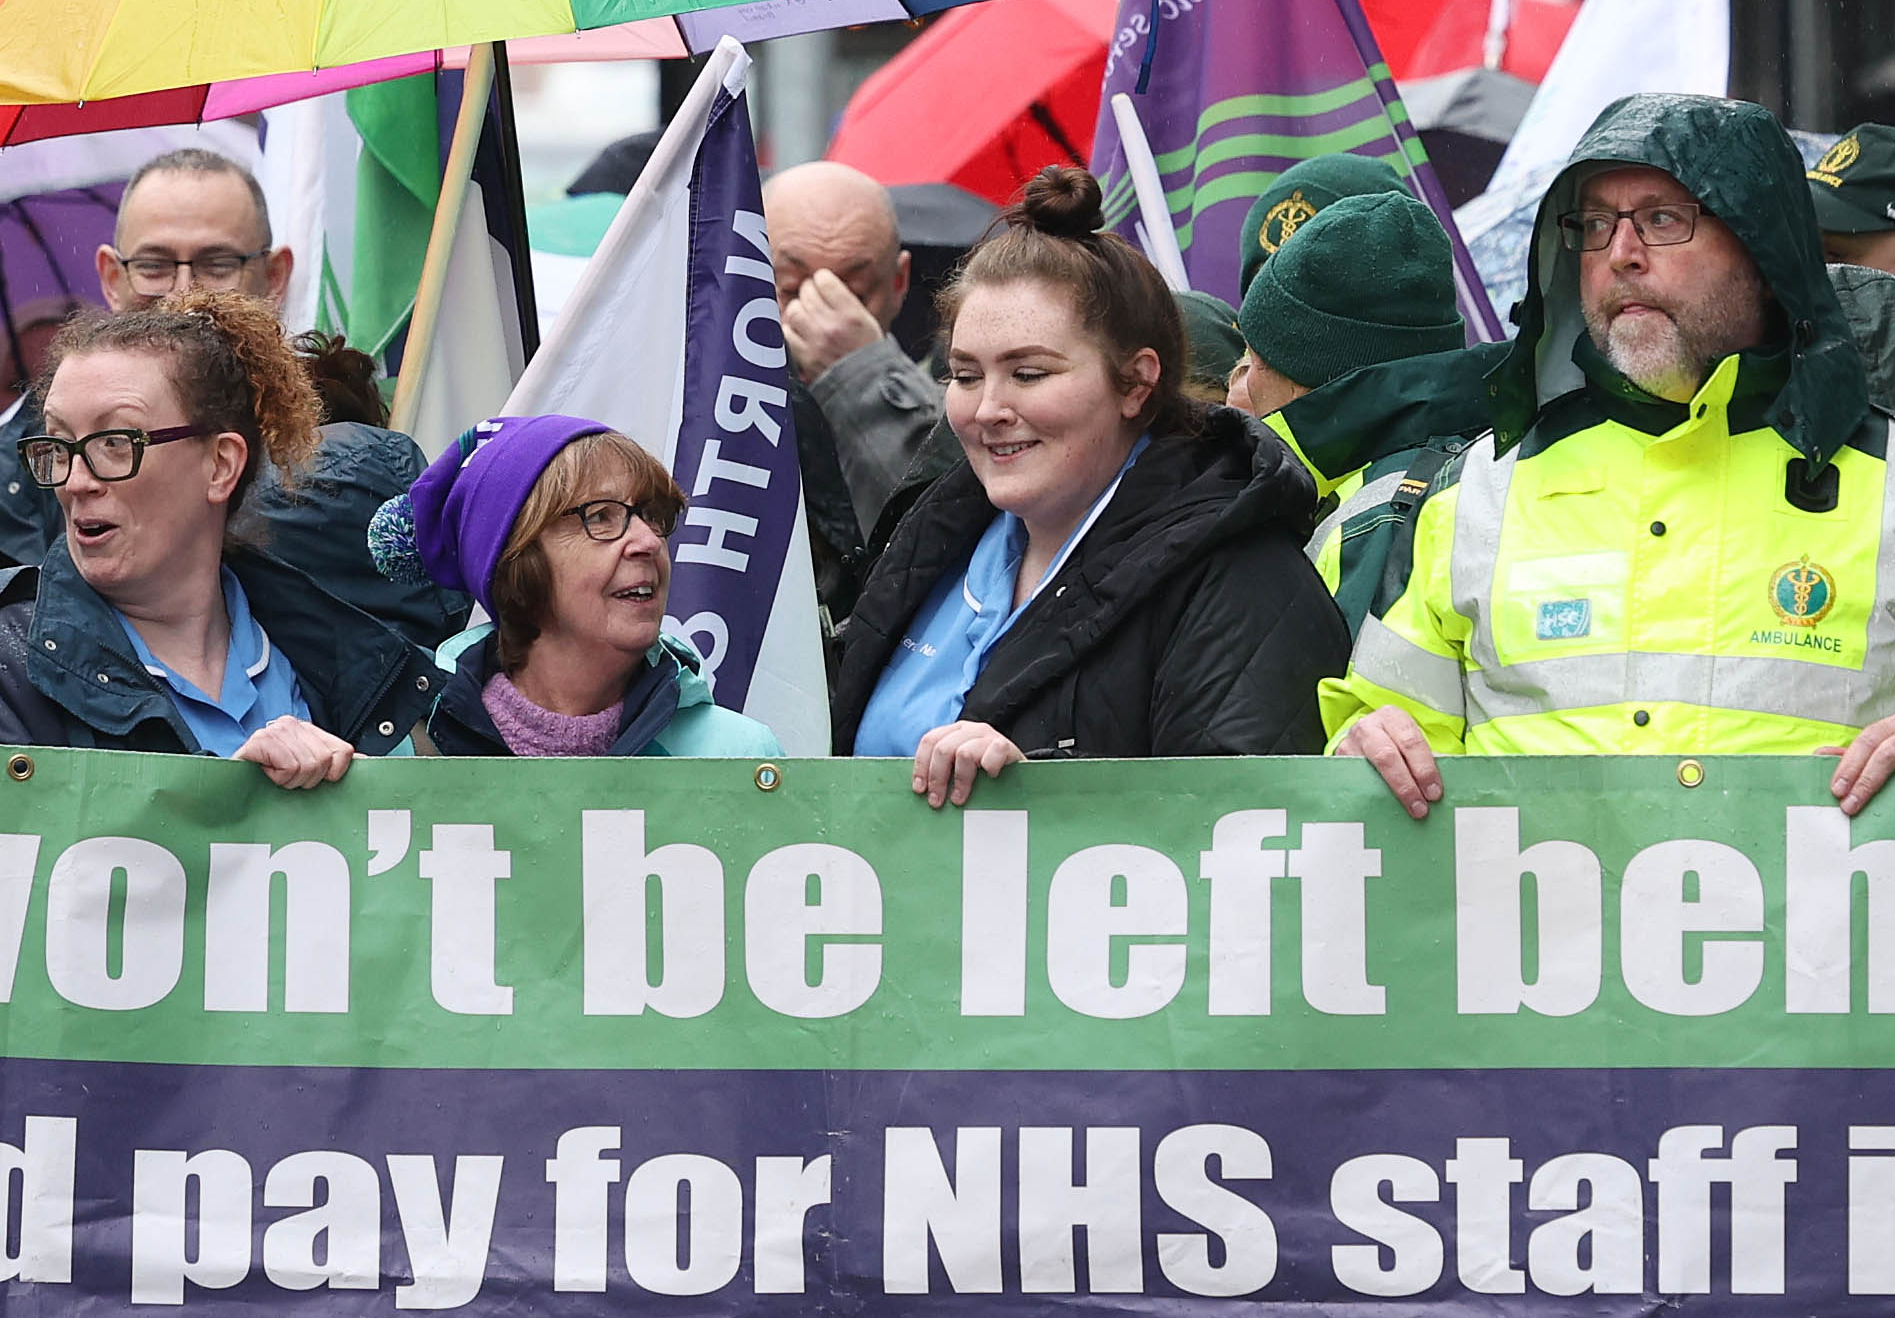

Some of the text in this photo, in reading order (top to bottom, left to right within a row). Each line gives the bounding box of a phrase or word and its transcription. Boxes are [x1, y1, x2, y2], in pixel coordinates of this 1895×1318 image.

[1749, 630, 1843, 654] AMBULANCE
[582, 807, 884, 1019] be
[960, 807, 1387, 1020] left
[131, 1147, 504, 1312] pay
[546, 1124, 833, 1296] for
[881, 1123, 1278, 1297] NHS
[1329, 1123, 1799, 1297] staff
